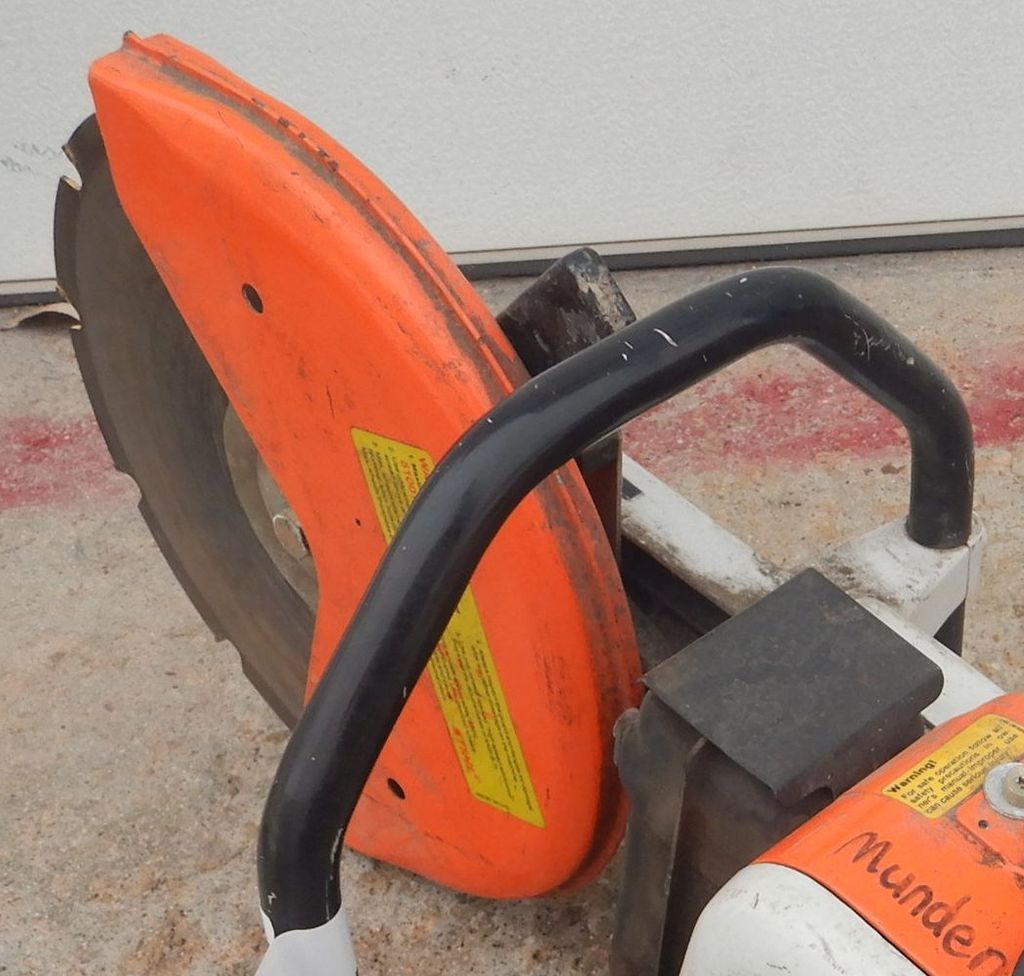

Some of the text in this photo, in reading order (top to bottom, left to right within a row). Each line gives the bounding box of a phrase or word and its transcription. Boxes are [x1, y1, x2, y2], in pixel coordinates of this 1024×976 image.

[887, 760, 937, 793] Warning!
[901, 789, 916, 799] For
[917, 777, 935, 790] safe
[935, 750, 968, 777] operation
[910, 786, 934, 803] safety
[938, 752, 980, 784] precautions
[918, 794, 938, 809] ner's
[925, 802, 941, 814] can
[940, 786, 963, 804] cause
